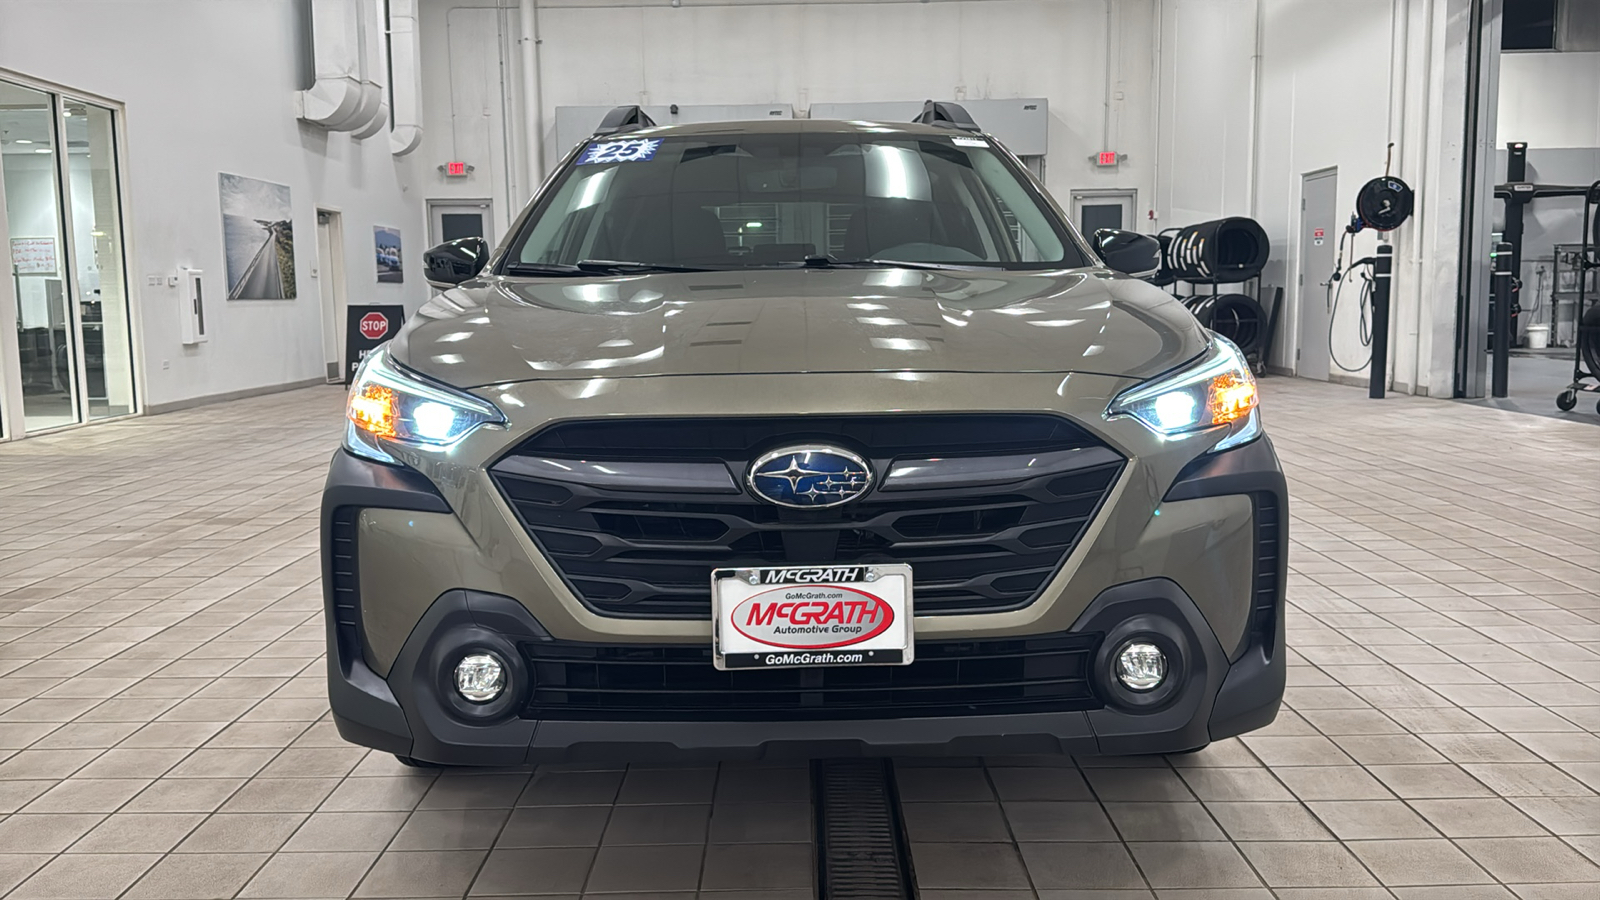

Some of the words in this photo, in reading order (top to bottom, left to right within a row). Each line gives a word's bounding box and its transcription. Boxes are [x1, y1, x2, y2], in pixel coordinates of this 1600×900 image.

[597, 143, 643, 158] 25
[1100, 152, 1115, 164] EXIT
[362, 320, 386, 331] STOP
[785, 591, 843, 600] GoMcGrath.com
[773, 625, 829, 635] Automotive
[832, 625, 862, 635] Group
[765, 652, 863, 665] GoMcGrath.com
